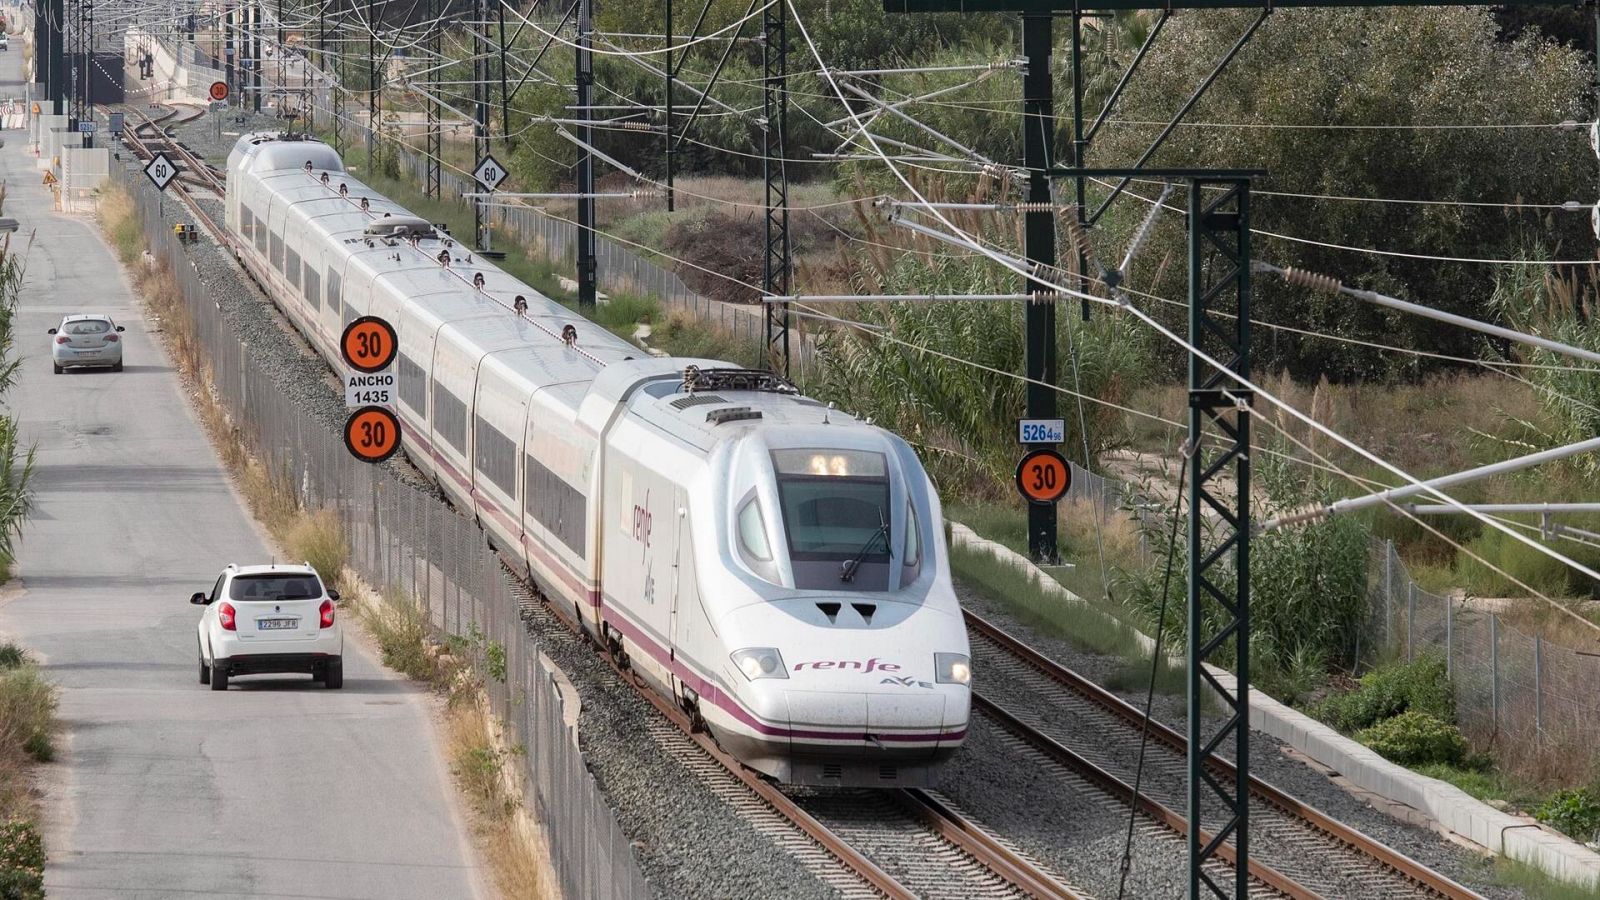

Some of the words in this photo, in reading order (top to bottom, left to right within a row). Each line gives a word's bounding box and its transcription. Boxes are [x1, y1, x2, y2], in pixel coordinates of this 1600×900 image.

[215, 86, 224, 96] 30
[155, 164, 167, 178] 60
[484, 167, 496, 181] 60
[356, 331, 381, 358] 30
[349, 375, 394, 387] ANCHO
[354, 390, 389, 403] 1435
[361, 420, 385, 448] 30
[1032, 464, 1056, 490] 30
[632, 488, 652, 566] renfe
[794, 657, 902, 674] renfe
[879, 675, 935, 690] AVE
